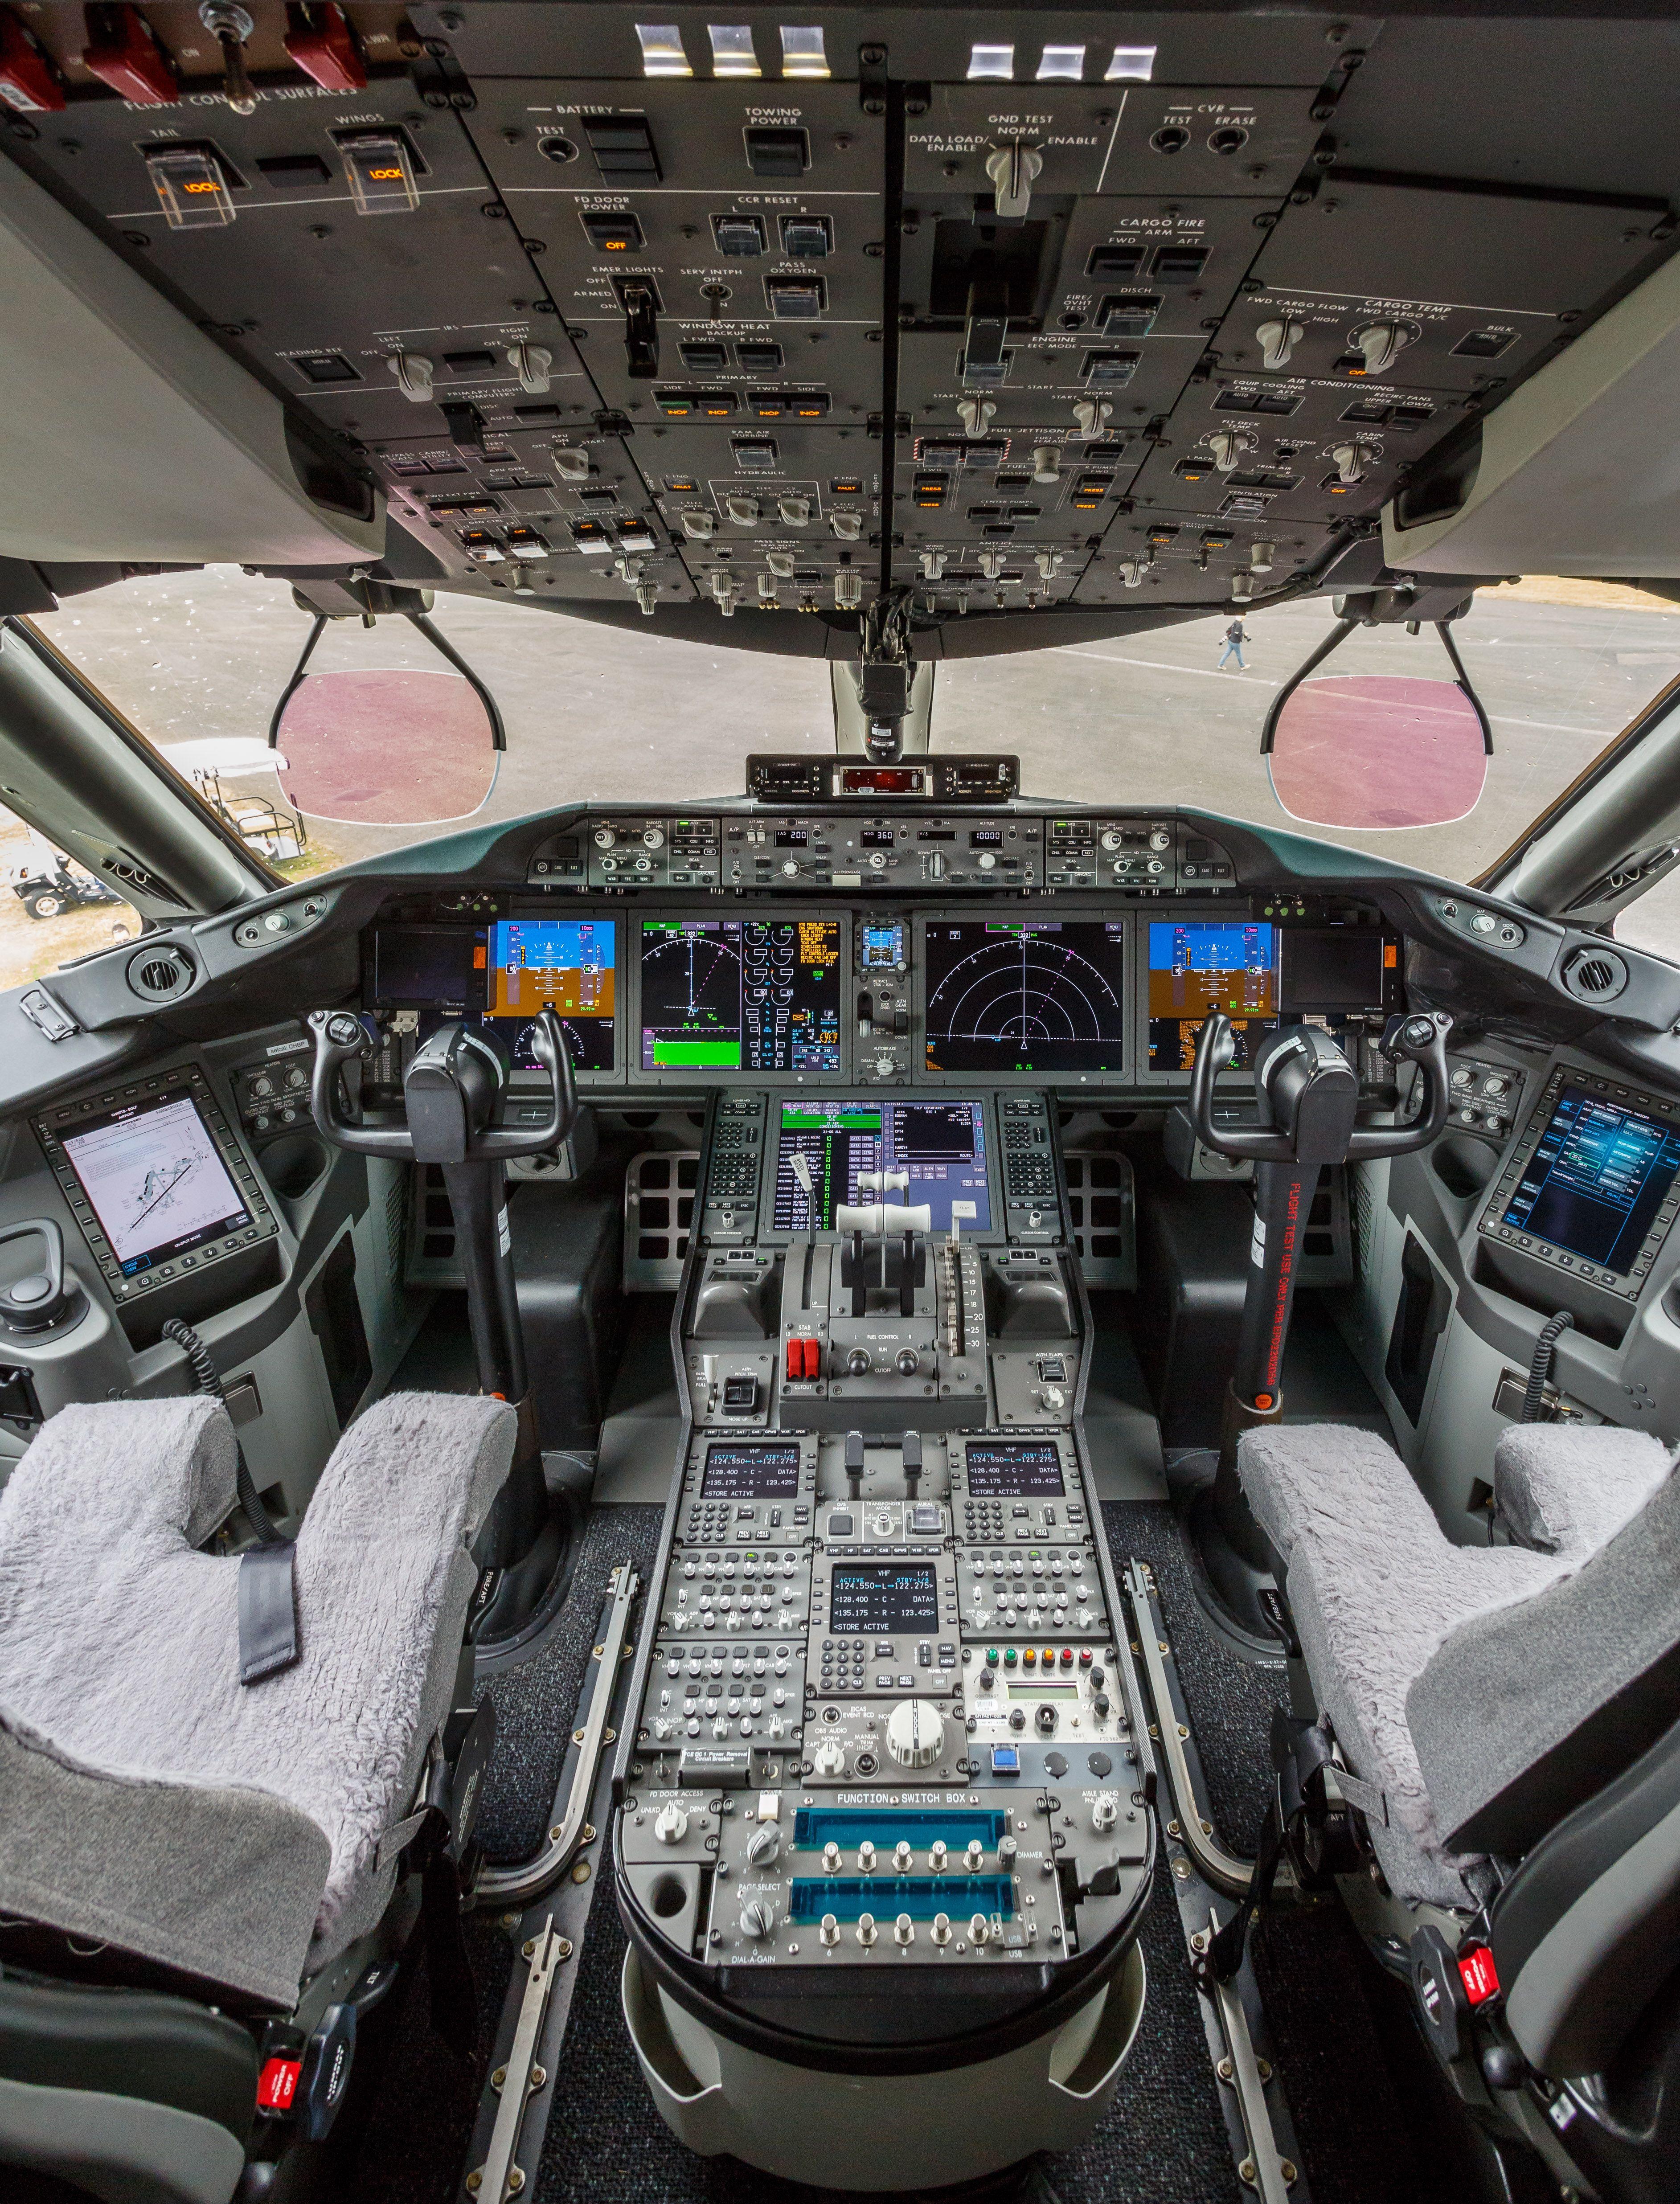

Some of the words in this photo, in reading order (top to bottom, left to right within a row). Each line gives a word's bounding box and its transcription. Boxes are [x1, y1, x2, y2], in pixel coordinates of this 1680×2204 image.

[745, 108, 801, 116] TOWING
[335, 114, 384, 124] WINGS
[370, 169, 405, 179] LOCK
[1365, 300, 1412, 309] CARGO
[1311, 380, 1394, 391] CONDITIONING
[793, 1160, 802, 1172] BRAKE
[796, 1158, 804, 1170] SPEED
[1287, 1183, 1301, 1220] FLIGHT
[1284, 1224, 1295, 1250] TEST
[1281, 1254, 1292, 1274] USE
[1277, 1277, 1290, 1301] ONLY
[1274, 1305, 1285, 1324] PER
[838, 1794, 888, 1803] FUNCTION
[902, 1794, 939, 1803] SWITCH
[947, 1794, 965, 1803] BOX
[1464, 1970, 1475, 1990] OFF
[1471, 1958, 1485, 1994] POWER
